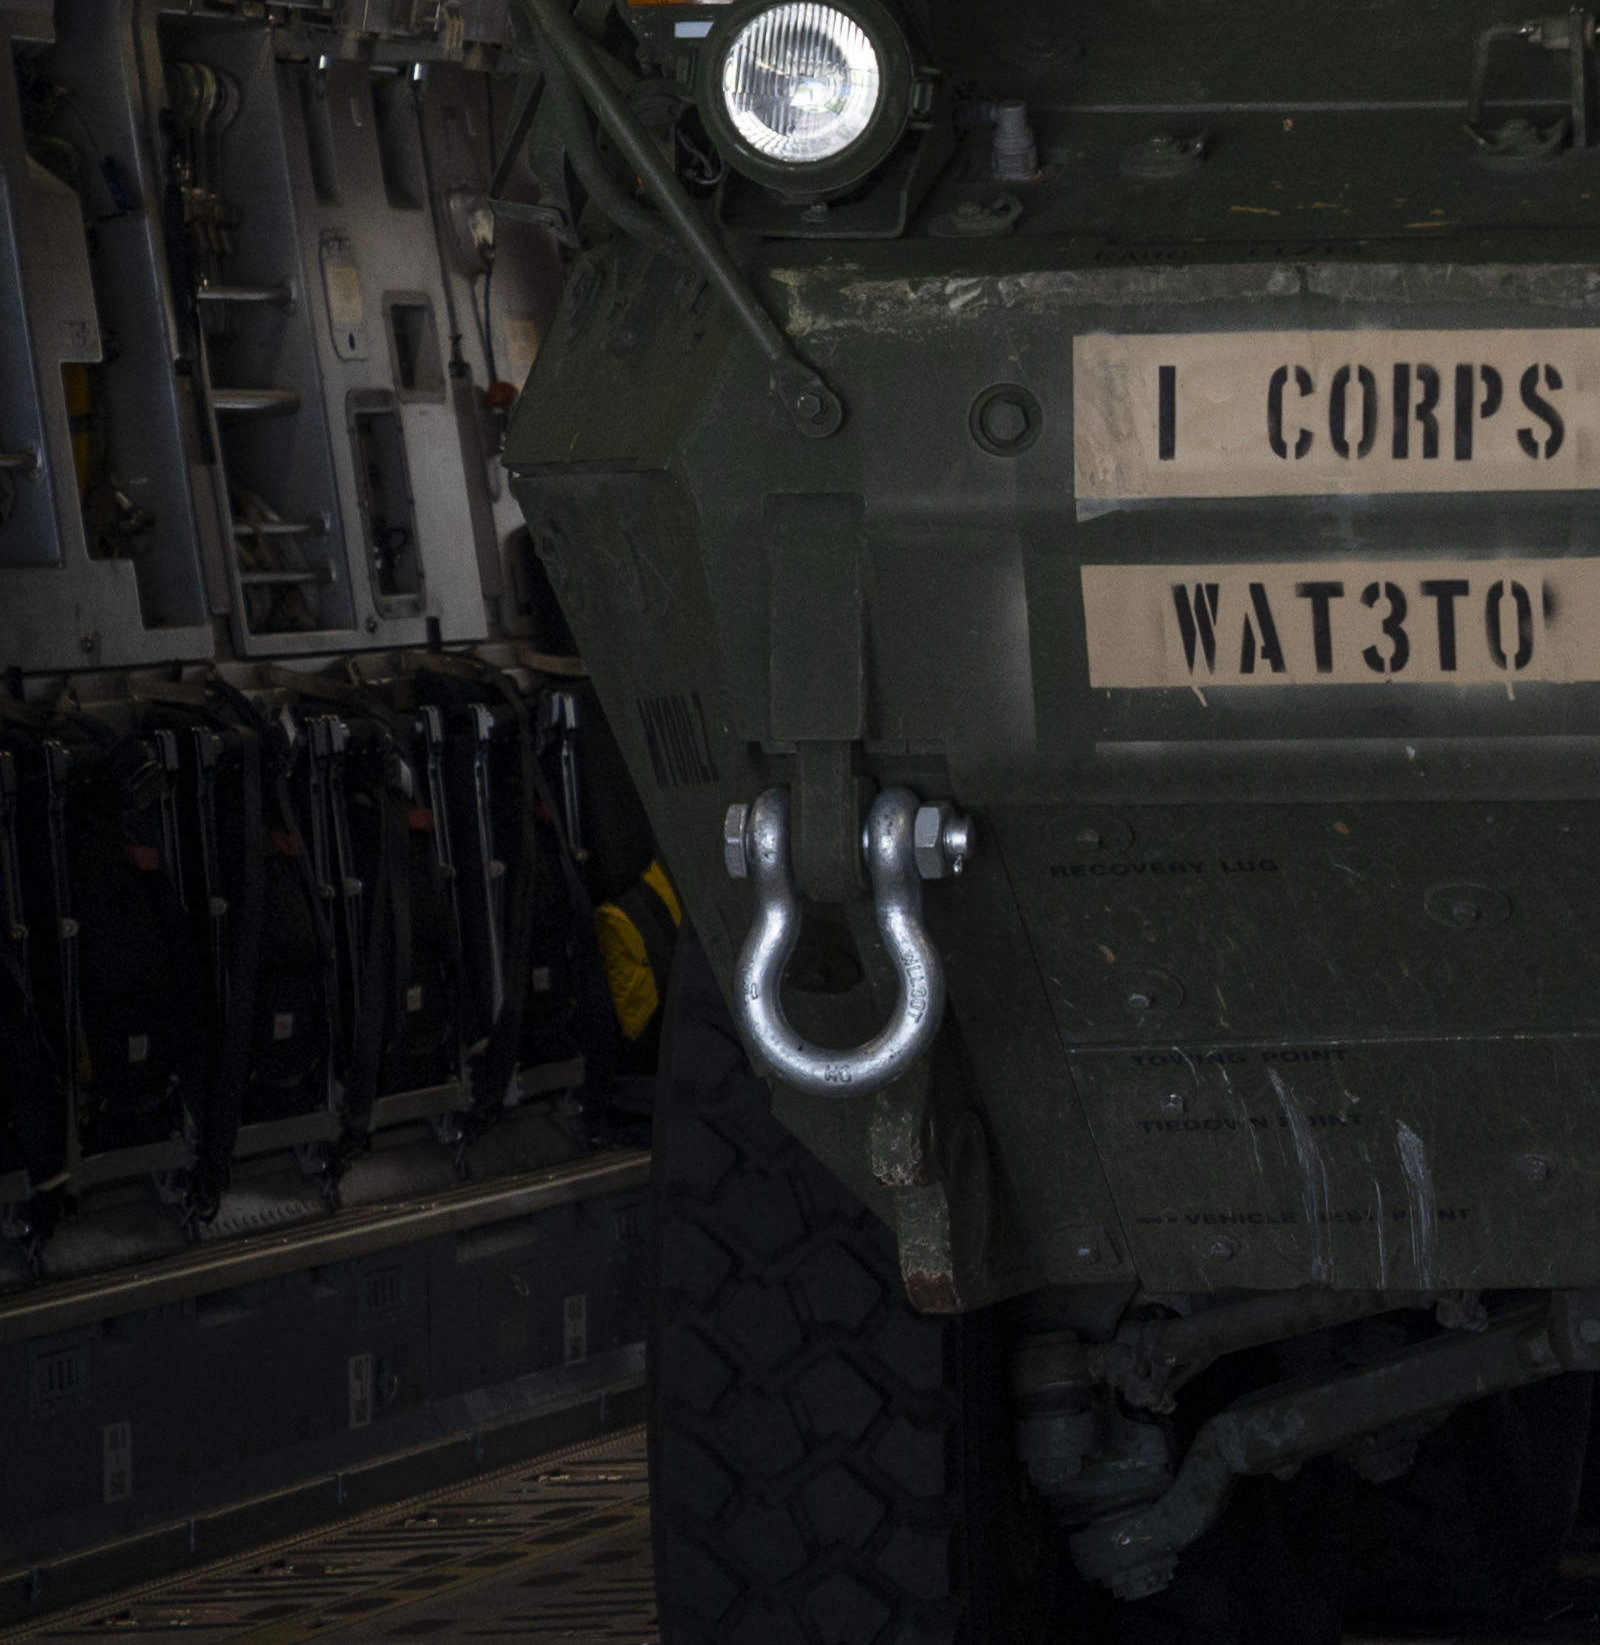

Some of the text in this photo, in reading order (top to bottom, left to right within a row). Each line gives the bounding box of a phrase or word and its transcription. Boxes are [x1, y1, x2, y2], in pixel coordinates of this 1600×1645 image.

[1158, 362, 1565, 461] I CORPS
[1050, 859, 1280, 878] RECOVERY LUG
[1131, 1048, 1349, 1067] TOWING POINT
[1391, 1207, 1471, 1222] PNT
